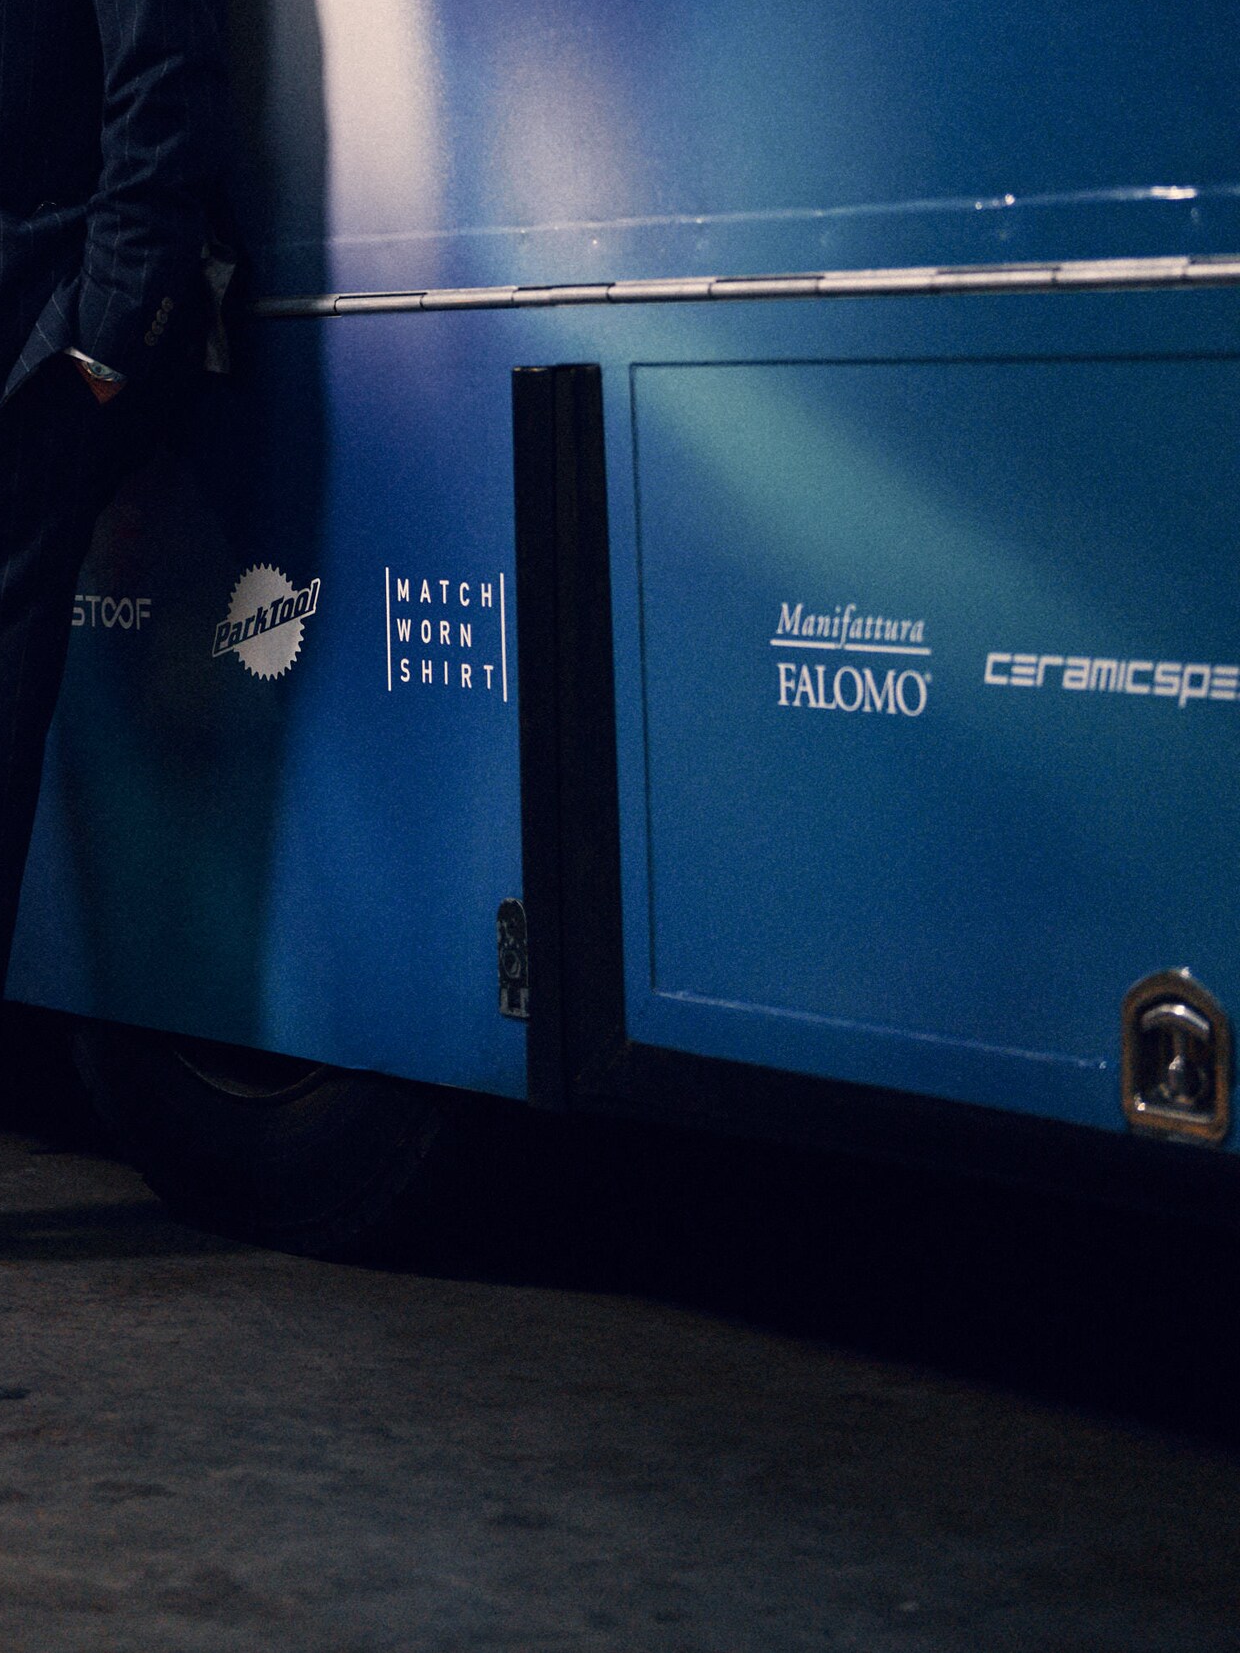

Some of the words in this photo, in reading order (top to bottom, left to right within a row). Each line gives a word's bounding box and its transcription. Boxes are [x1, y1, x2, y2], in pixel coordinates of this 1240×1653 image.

[397, 577, 492, 608] MATCH
[396, 618, 472, 648] WORN
[776, 603, 925, 649] Manifattura
[400, 658, 494, 690] SHIRT
